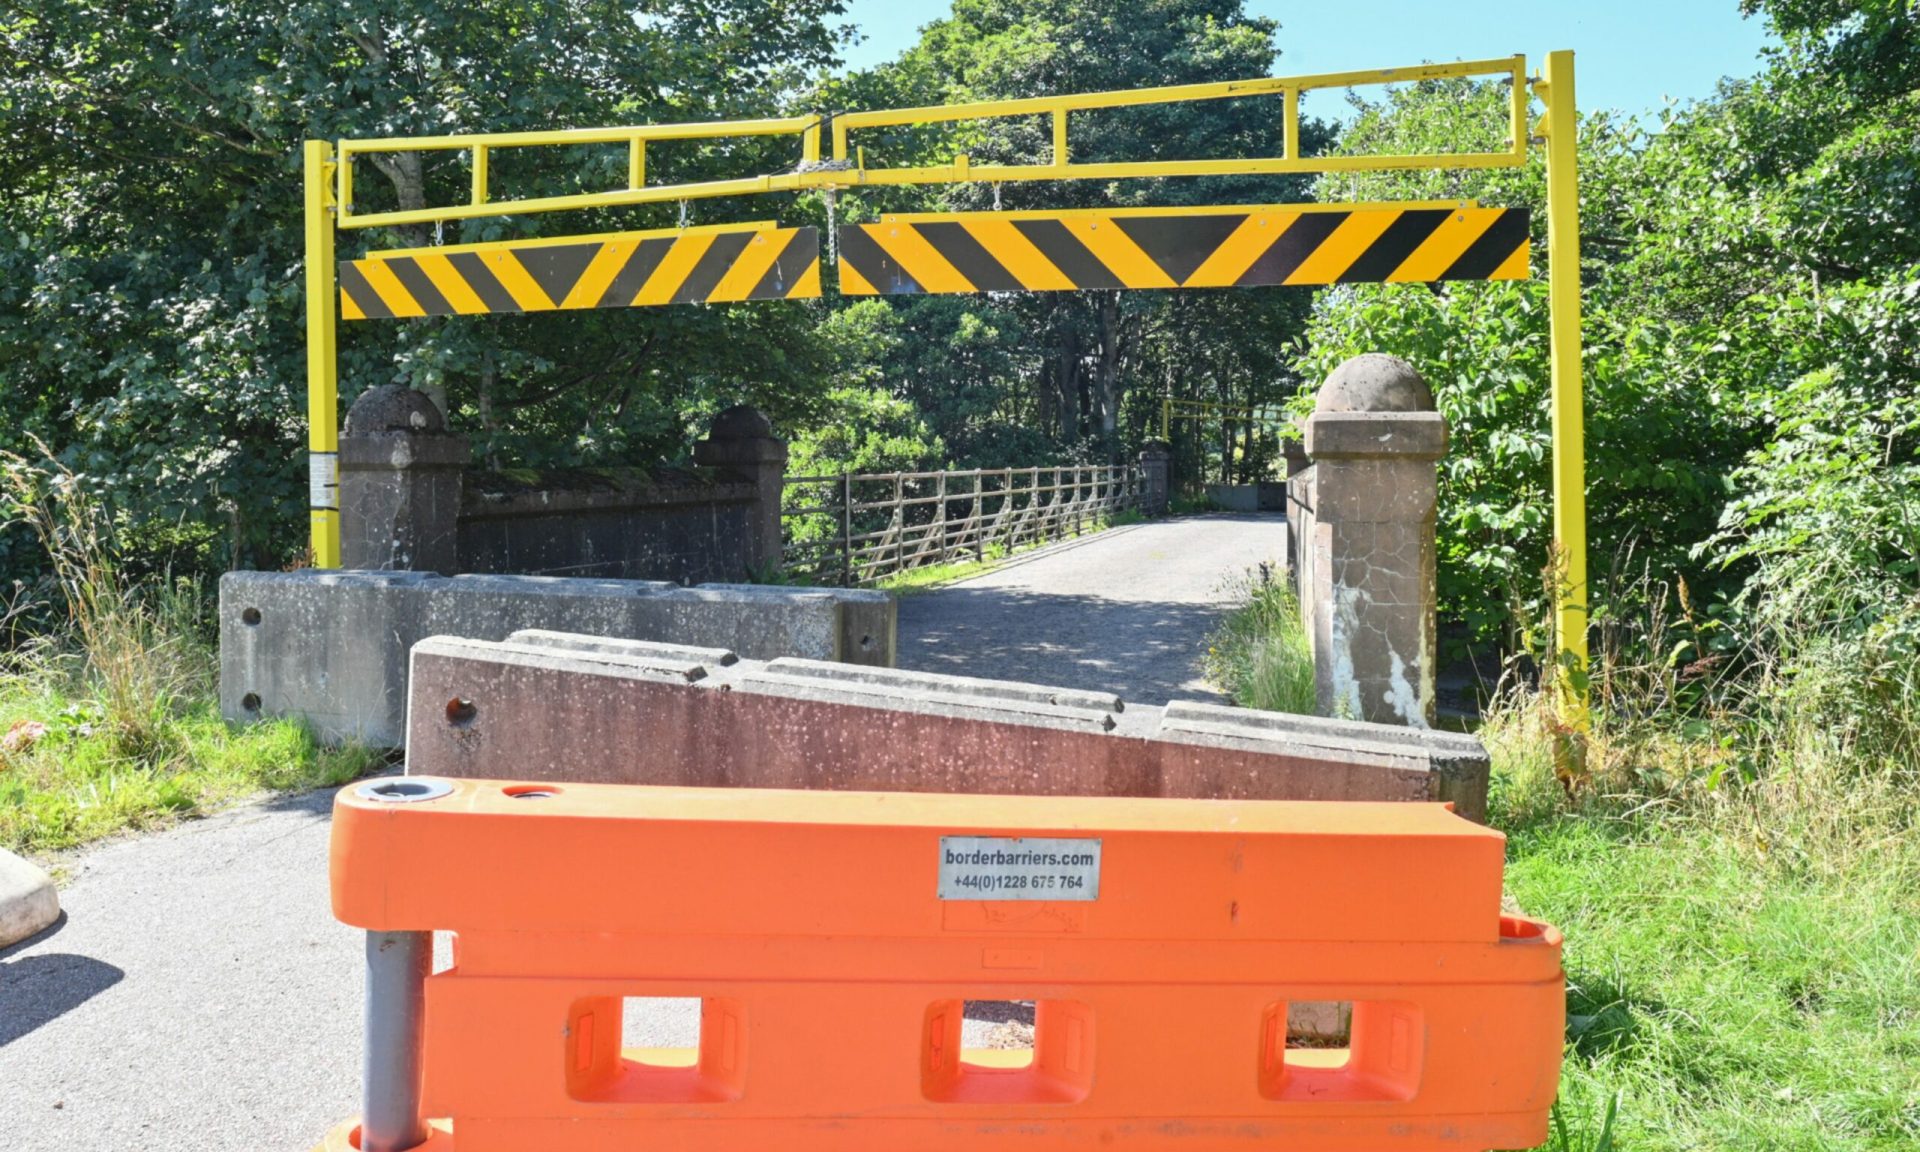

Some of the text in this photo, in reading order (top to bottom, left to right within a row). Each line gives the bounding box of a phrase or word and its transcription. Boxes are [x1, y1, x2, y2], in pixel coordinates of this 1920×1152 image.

[945, 849, 1094, 866] borderbarriers.com
[954, 875, 1083, 892] +44(0)1228 675 764
